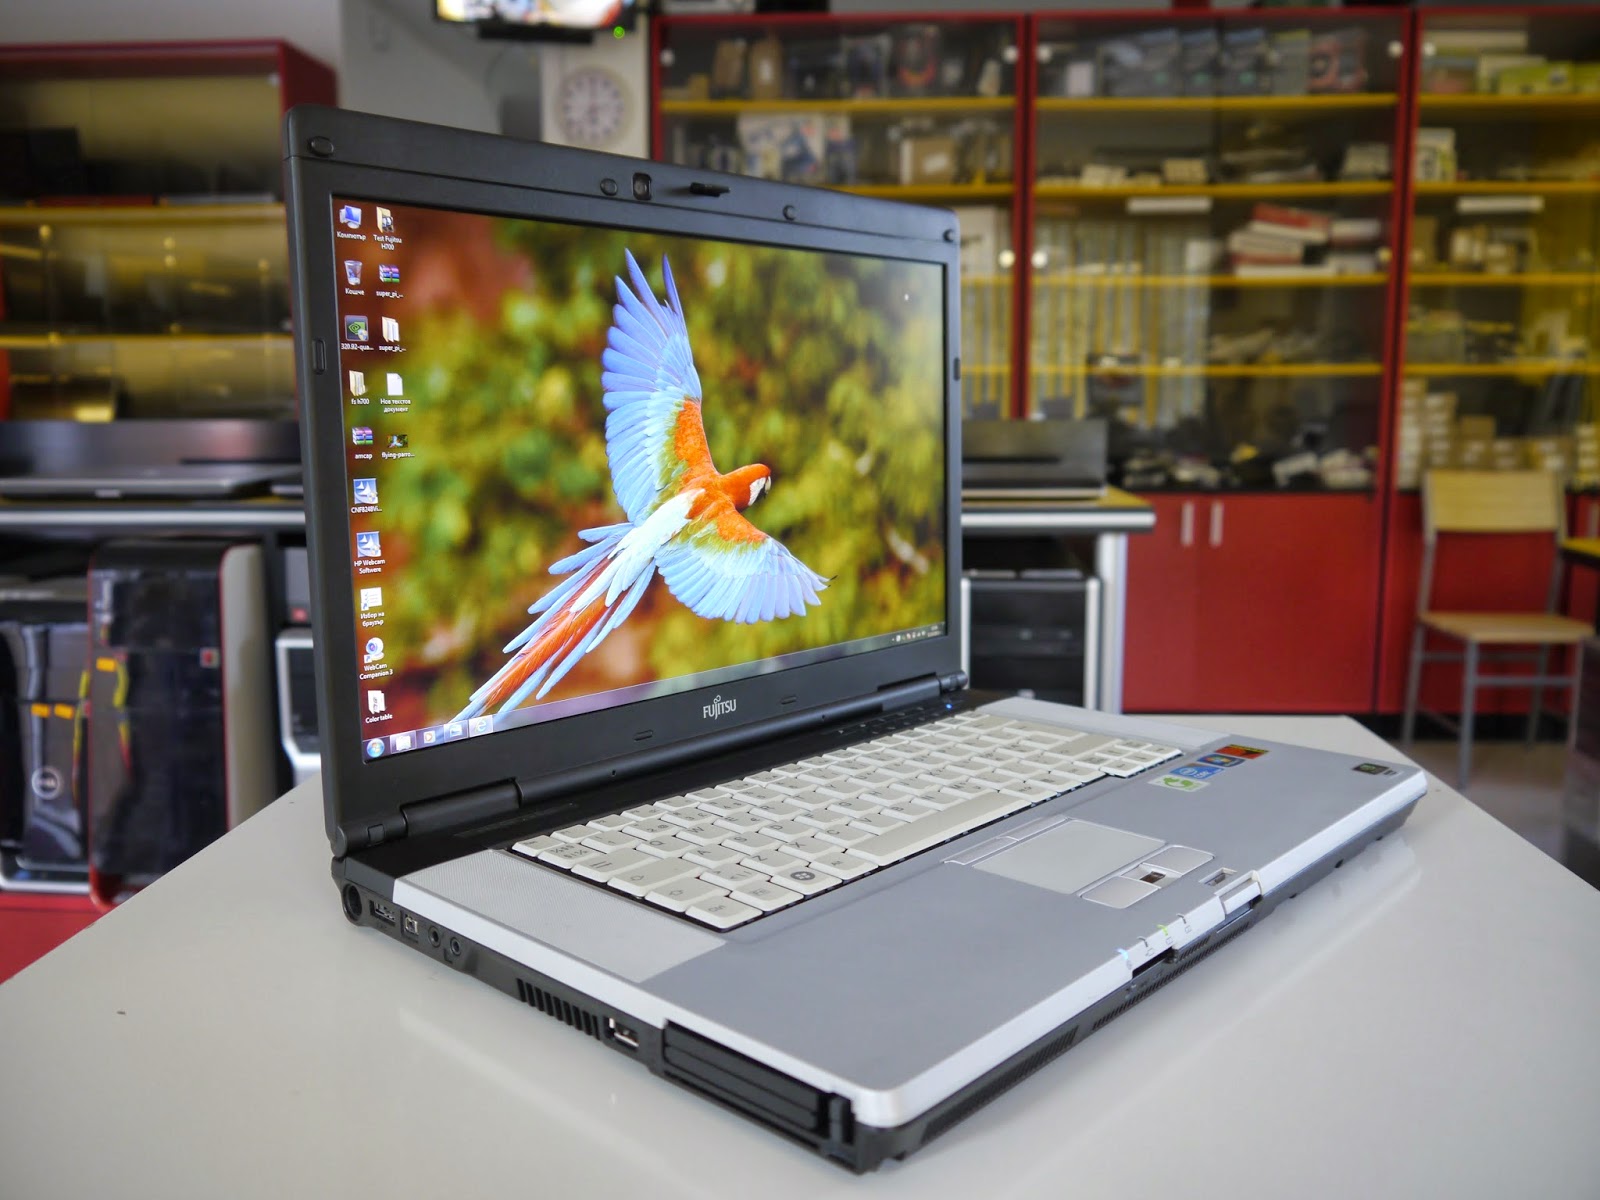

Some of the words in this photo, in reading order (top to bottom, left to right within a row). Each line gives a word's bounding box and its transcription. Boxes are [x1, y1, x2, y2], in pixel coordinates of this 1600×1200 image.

[373, 234, 384, 242] Test
[385, 235, 402, 244] Fujitsu
[359, 670, 389, 680] Companion
[703, 695, 737, 720] FUJITSU
[365, 716, 380, 724] Color
